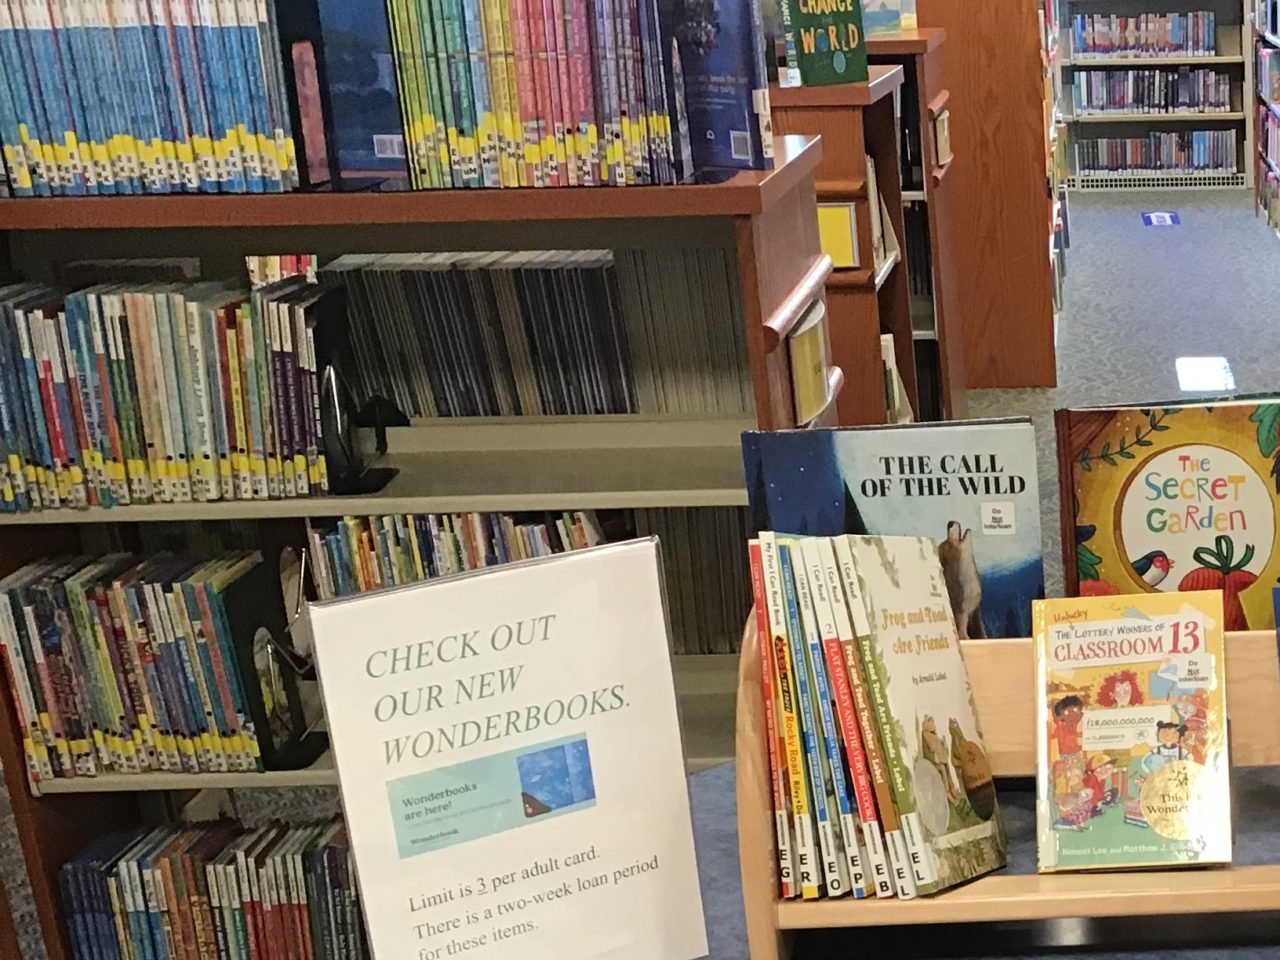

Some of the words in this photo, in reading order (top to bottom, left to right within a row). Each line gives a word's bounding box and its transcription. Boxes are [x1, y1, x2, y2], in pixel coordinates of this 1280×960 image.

[879, 455, 932, 475] THE
[940, 454, 1003, 474] CALL
[861, 478, 893, 497] OF
[901, 477, 950, 496] THE
[958, 475, 1025, 495] WILD
[765, 542, 772, 552] My
[882, 608, 906, 630] Frog
[908, 609, 924, 624] and
[926, 607, 948, 623] Toad
[366, 630, 480, 678] CHECK
[490, 614, 556, 651] OUT
[862, 640, 872, 662] Frog
[916, 636, 949, 656] Friends
[1054, 636, 1164, 662] CLASSROOM
[1168, 620, 1200, 654] 13
[829, 642, 839, 668] FLAT
[834, 668, 850, 705] STANLEY
[868, 664, 878, 681] and
[374, 684, 443, 722] OUR
[455, 665, 525, 704] NEW
[873, 683, 884, 706] Toad
[384, 684, 630, 765] WONDERBOOKS.
[845, 645, 855, 667] Frog
[851, 668, 860, 685] and
[856, 686, 866, 709] Toad
[861, 710, 875, 750] Together
[872, 758, 884, 784] Lobel
[878, 706, 888, 723] Are
[785, 716, 796, 747] Rocky
[883, 723, 896, 758] Friends
[788, 750, 800, 775] Road
[893, 767, 904, 792] Lobel
[401, 782, 477, 808] Wonderbooks
[405, 808, 423, 820] are
[424, 801, 452, 816] here!
[410, 827, 459, 846] Wonderbook
[800, 854, 807, 865] E
[409, 887, 455, 912] Limit
[460, 882, 473, 898] is
[477, 877, 488, 895] 3
[491, 867, 516, 891] per
[521, 857, 560, 880] adult
[564, 846, 600, 867] card.
[801, 872, 811, 882] R
[413, 917, 461, 940] There
[466, 910, 479, 925] is
[484, 908, 493, 920] a
[497, 882, 573, 916] two-week
[577, 872, 608, 892] loan
[613, 855, 659, 888] period
[446, 932, 487, 956] these
[492, 919, 539, 942] items.
